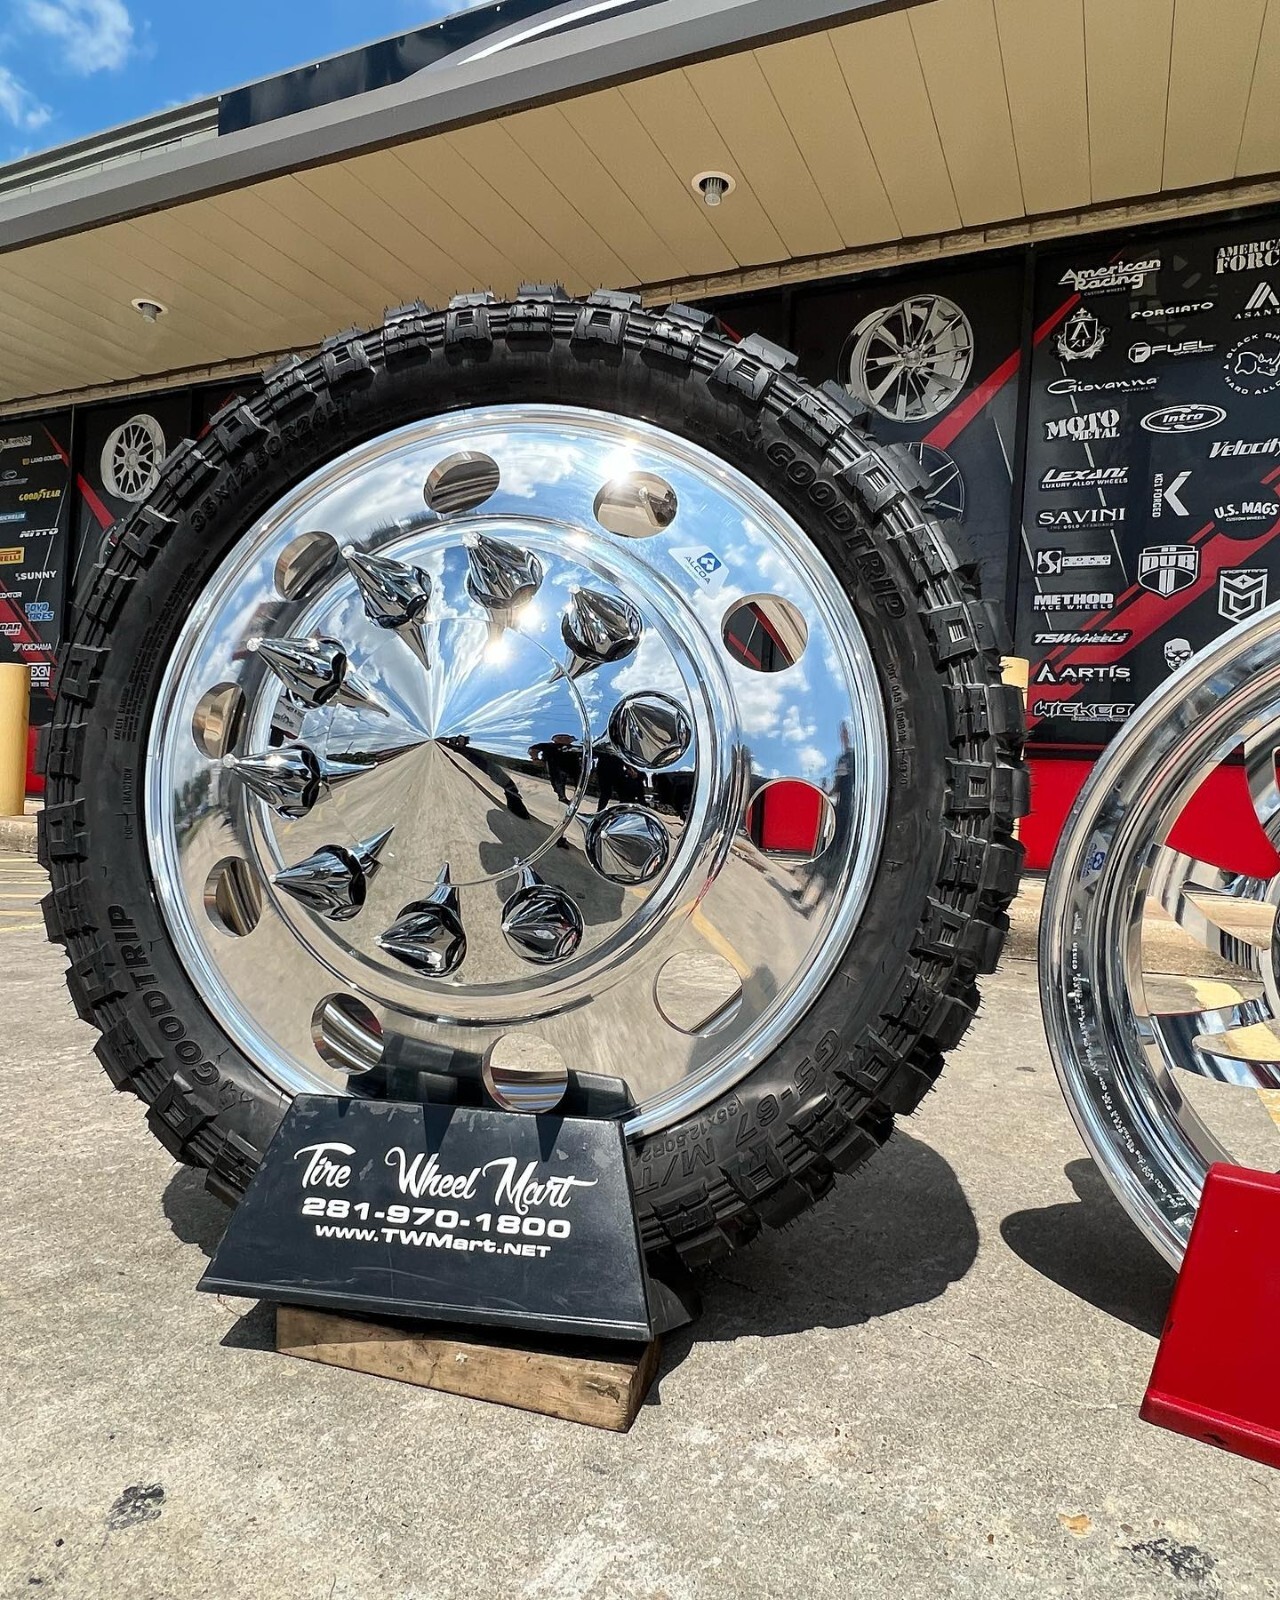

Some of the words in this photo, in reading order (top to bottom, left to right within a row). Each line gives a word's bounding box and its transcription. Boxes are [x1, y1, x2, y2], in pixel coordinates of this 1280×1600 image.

[1058, 258, 1161, 284] American
[1074, 272, 1146, 291] Racing
[1131, 302, 1214, 319] FORGIATO
[1151, 340, 1217, 355] FUEL
[1047, 376, 1157, 394] Giovanna
[1045, 409, 1121, 440] MOTO
[1162, 412, 1205, 423] Intro
[1072, 427, 1121, 441] METAL
[1072, 479, 1096, 487] ALLOY
[1097, 477, 1129, 485] WHEELS
[1038, 508, 1126, 525] SAVINI
[1214, 504, 1240, 519] U.S.
[1241, 502, 1280, 516] MAGS
[766, 440, 906, 619] GOODTRIP
[683, 555, 711, 585] ALCOA
[1142, 554, 1196, 574] DUB
[20, 570, 57, 580] SUNNY
[26, 604, 48, 613] TOYO
[1034, 593, 1114, 605] METHOD
[29, 612, 53, 620] TIRES
[1033, 700, 1136, 719] WICKED
[107, 904, 221, 1086] GOODTRIP
[735, 1028, 842, 1148] GS-67
[633, 1136, 716, 1197] M/T
[294, 1142, 357, 1189] Tire
[384, 1146, 482, 1200] Wheel
[482, 1157, 599, 1214] Mart
[301, 1196, 572, 1239] 281-970-1800
[314, 1223, 552, 1259] www.TWMart.NET
